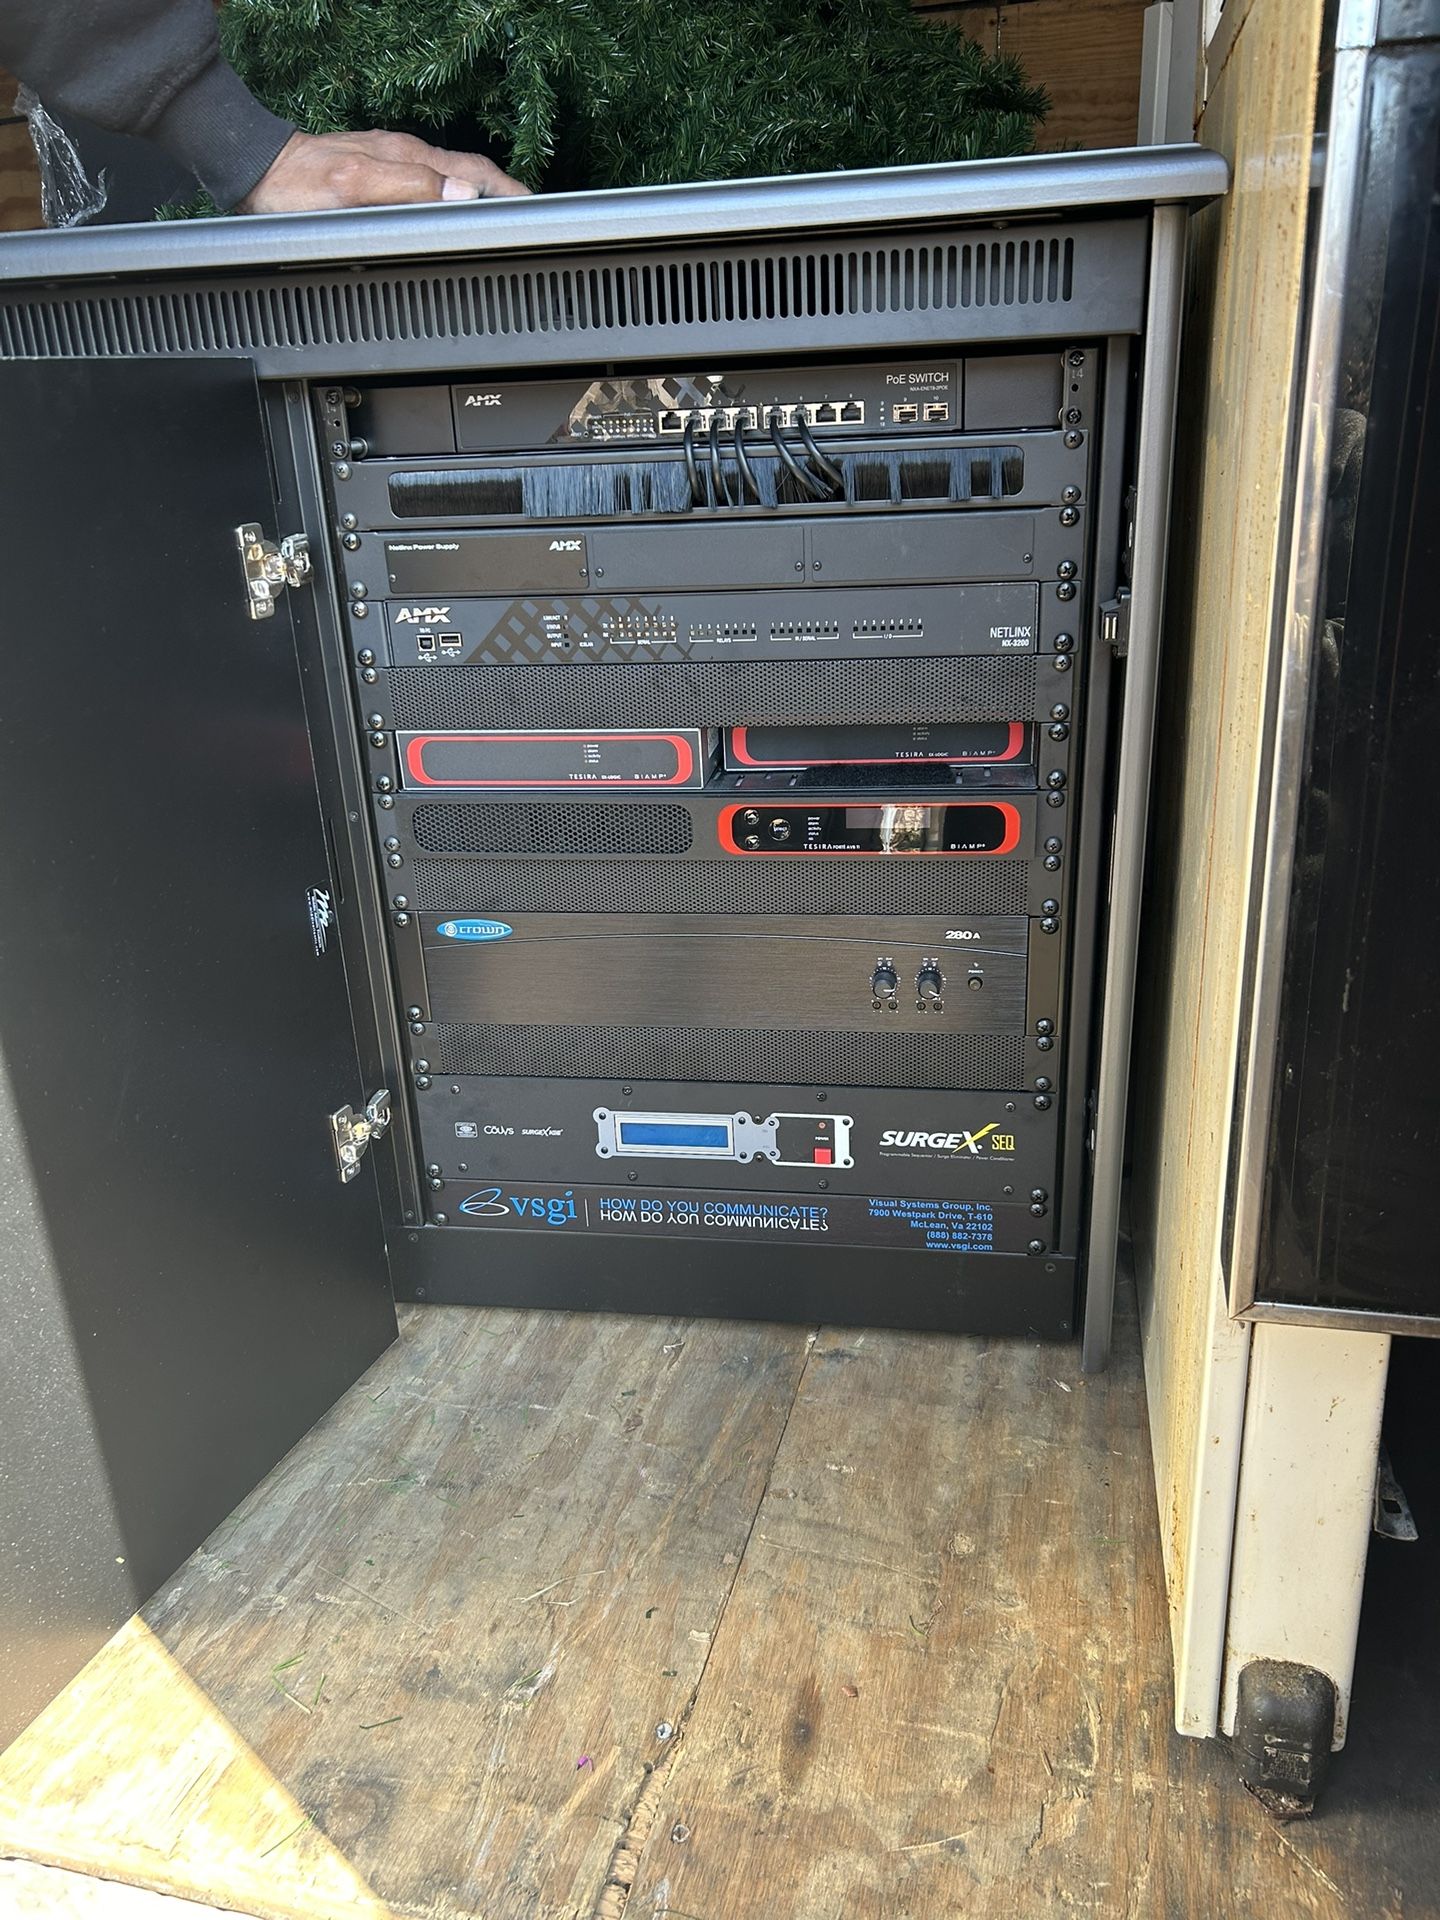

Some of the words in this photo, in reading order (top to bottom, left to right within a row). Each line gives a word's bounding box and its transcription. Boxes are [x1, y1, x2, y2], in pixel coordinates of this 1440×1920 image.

[886, 374, 906, 384] PoE
[908, 372, 949, 384] SWITCH
[464, 394, 502, 406] AMX
[549, 540, 582, 550] AMX
[394, 607, 451, 624] AMX
[990, 626, 1031, 638] NETLINX
[992, 1134, 1015, 1150] SEQ
[509, 1191, 577, 1225] vsgi
[600, 1198, 636, 1210] HOW
[640, 1200, 663, 1211] DO
[667, 1201, 699, 1213] YOU
[704, 1202, 828, 1218] COMMUNICATE?
[869, 1199, 897, 1207] Visual
[900, 1200, 939, 1210] Systems
[976, 1203, 993, 1211] Inc.
[869, 1208, 890, 1217] 7900
[892, 1210, 936, 1219] Westpark
[910, 1221, 949, 1230] McLean,
[926, 1231, 950, 1240] (888)
[926, 1242, 993, 1252] www.vsgi.com
